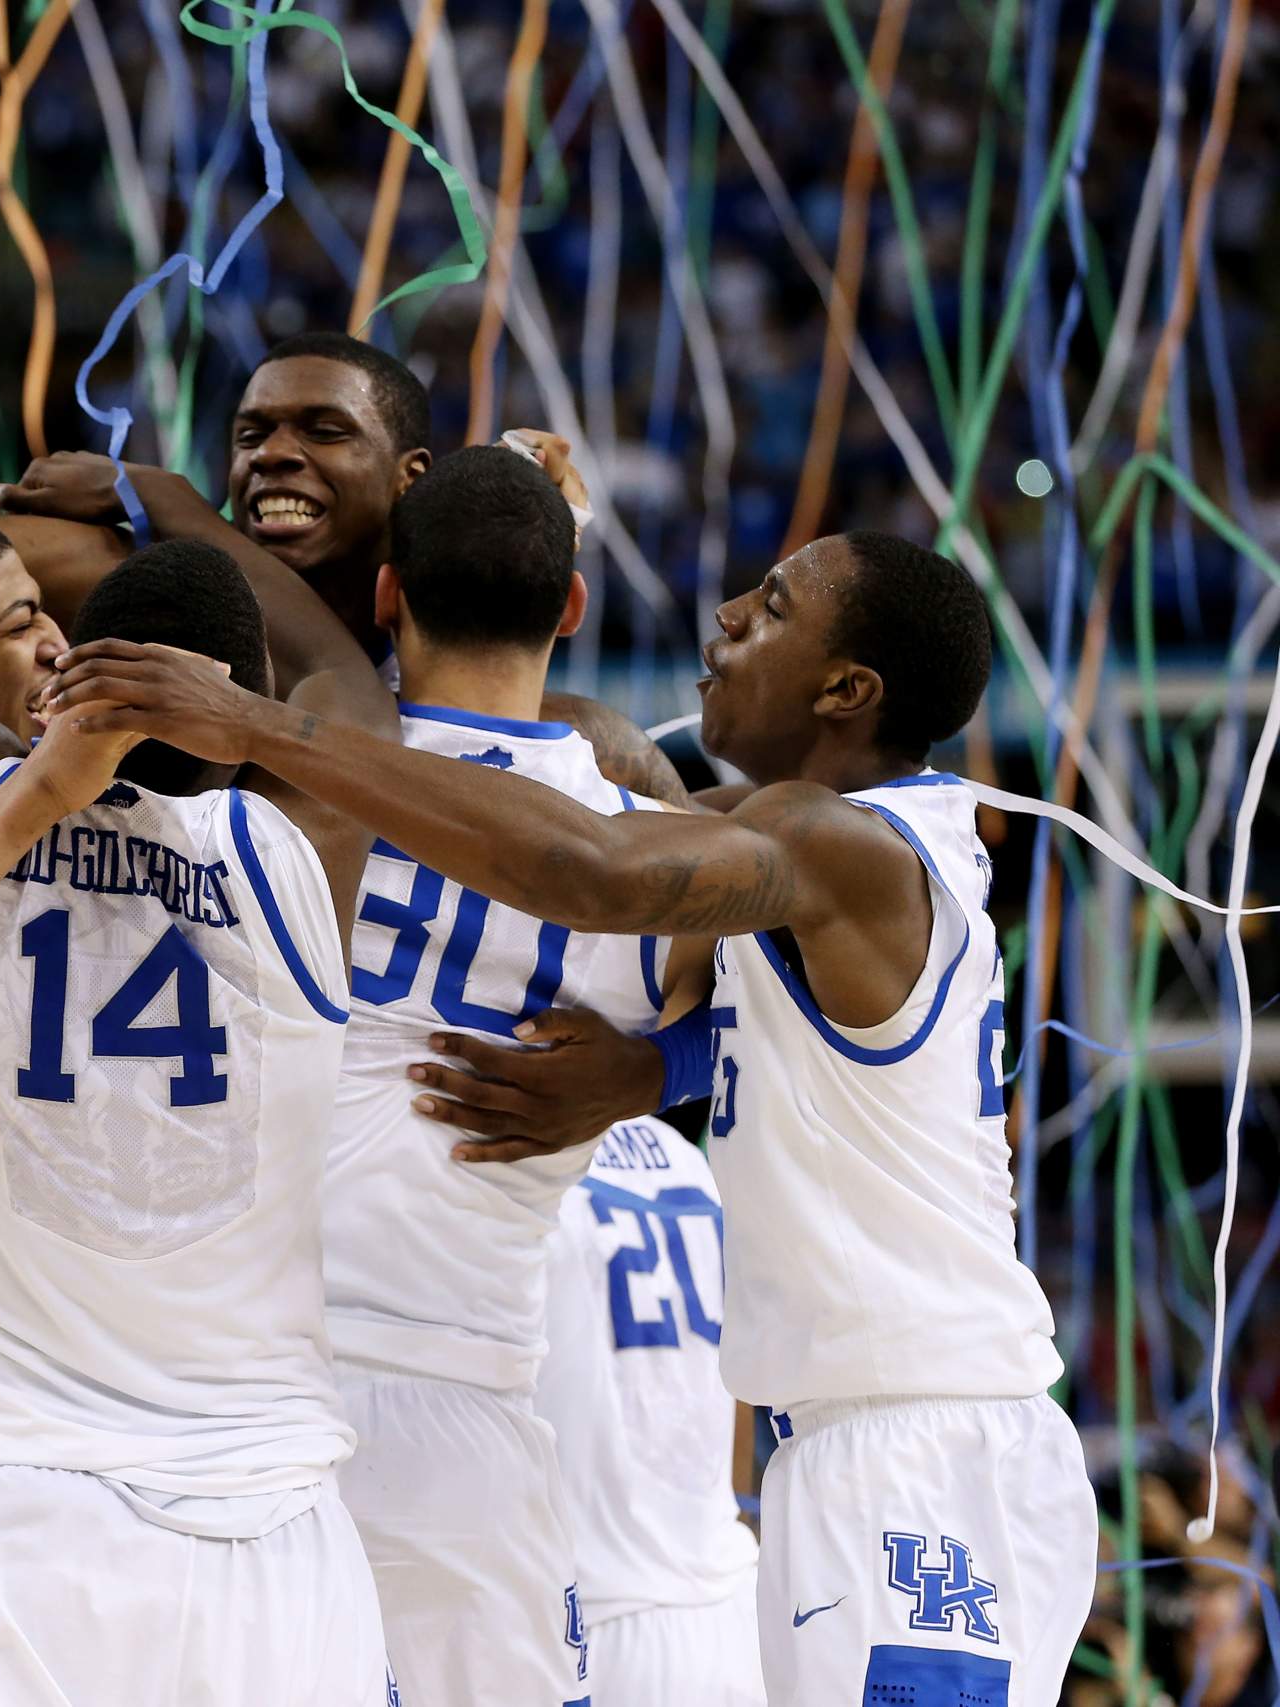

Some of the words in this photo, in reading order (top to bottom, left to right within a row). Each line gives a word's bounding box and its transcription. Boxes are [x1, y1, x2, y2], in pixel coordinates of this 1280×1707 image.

[17, 908, 228, 1107] 14
[351, 837, 570, 1041] 30
[588, 1186, 724, 1350] 20
[883, 1531, 1000, 1645] UK
